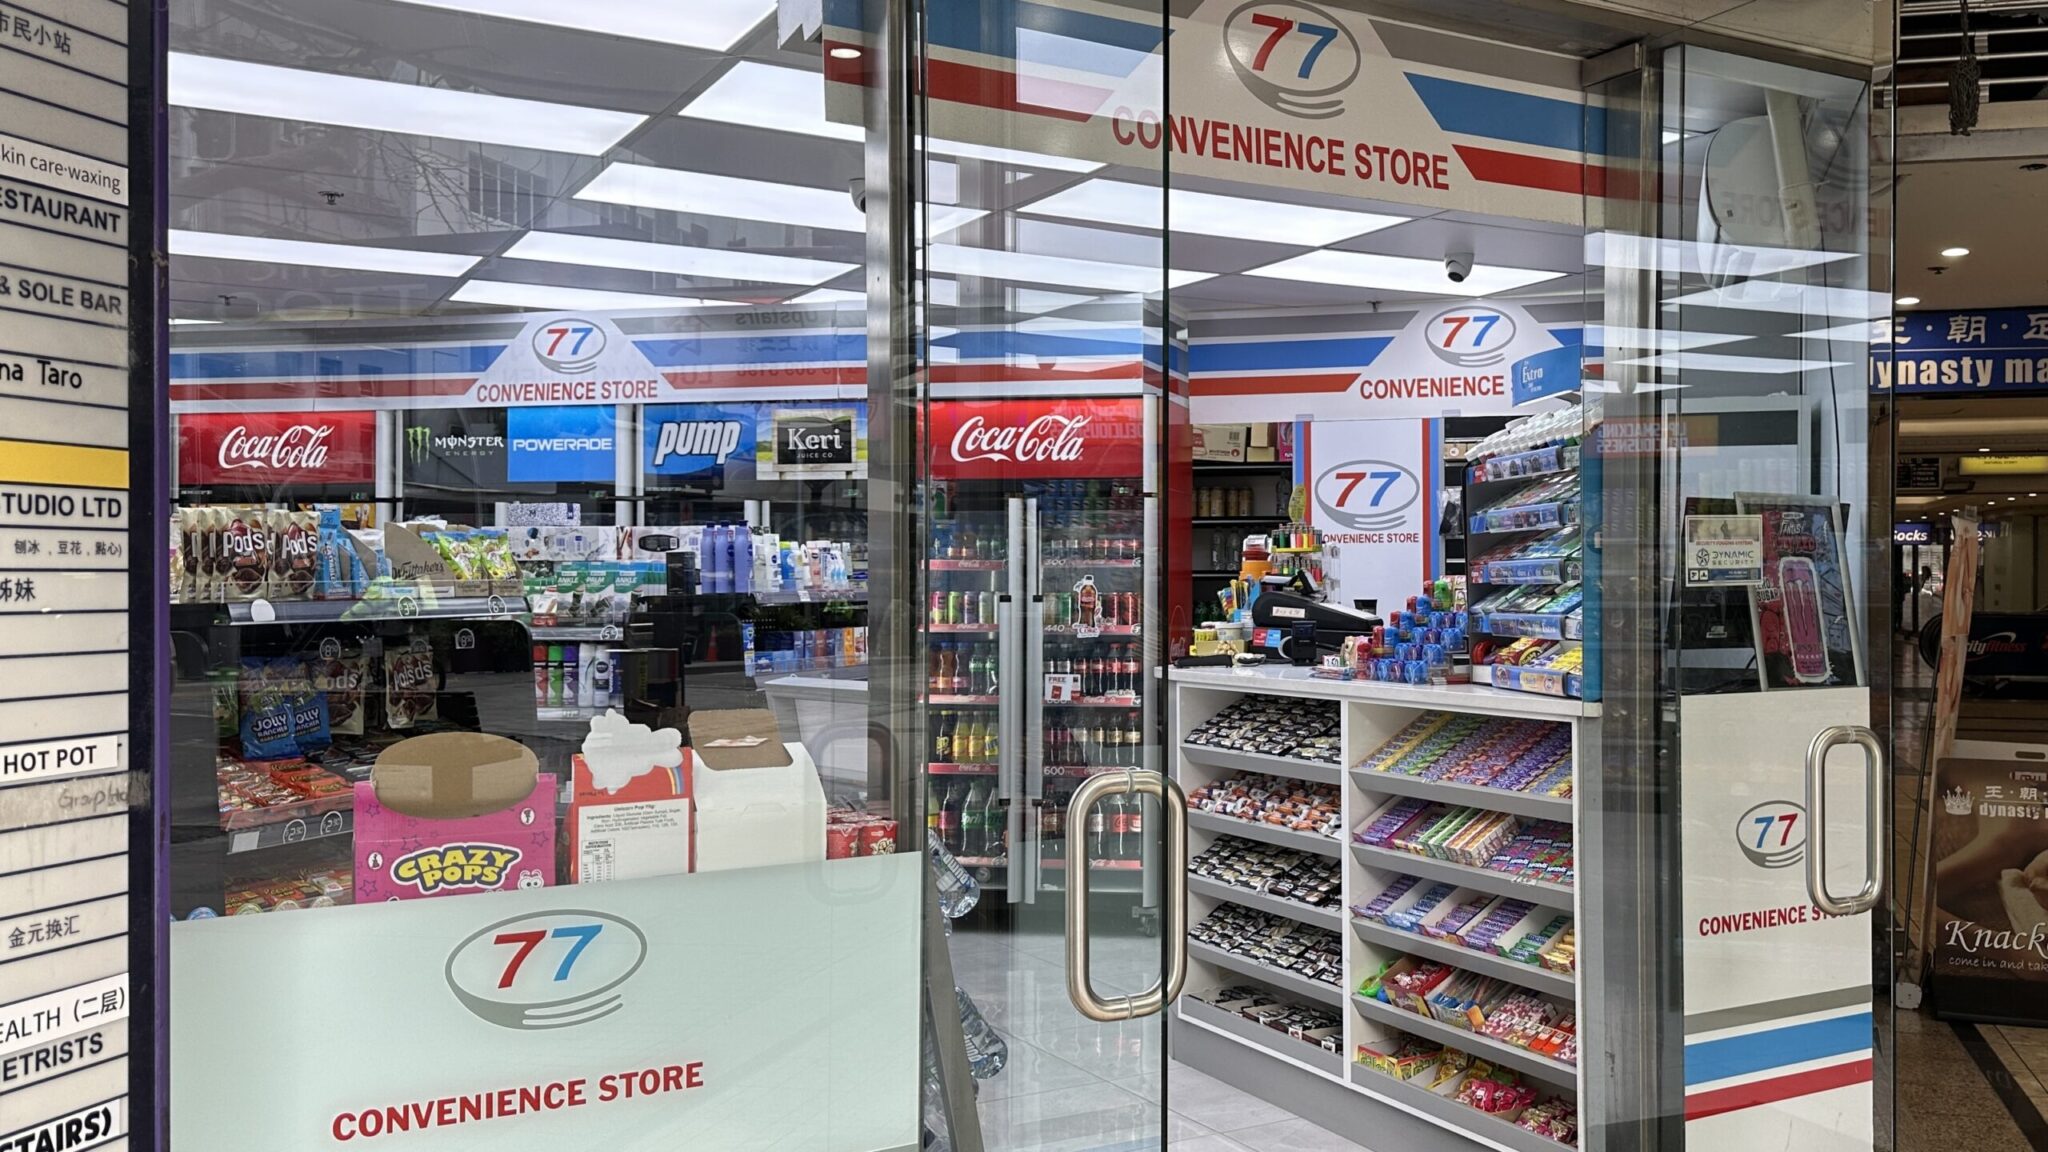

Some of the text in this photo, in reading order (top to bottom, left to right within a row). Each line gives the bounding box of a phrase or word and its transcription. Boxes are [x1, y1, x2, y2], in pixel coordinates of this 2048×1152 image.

[1251, 13, 1338, 80] 77
[1113, 106, 1449, 190] CONVENIENCE STORE
[19, 279, 74, 307] SOLE
[80, 290, 122, 315] BAR
[546, 327, 594, 356] 77
[1443, 315, 1500, 348] 77
[37, 360, 83, 390] Taro
[1522, 366, 1544, 383] Extra
[1870, 356, 1993, 388] ynasty
[477, 380, 658, 402] CONVENIENCE STORE
[1360, 375, 1504, 399] CONVENIENCE
[513, 437, 612, 451] POWERADE
[654, 421, 742, 466] pump
[788, 427, 842, 451] Keri
[1335, 471, 1401, 507] 77
[83, 496, 122, 518] LTD
[223, 530, 266, 557] Pods
[281, 533, 318, 559] Pods
[1322, 532, 1419, 544] ONVENIENCE STORE
[1712, 550, 1754, 559] DYNAMIC
[1044, 624, 1065, 632] 440
[326, 668, 359, 690] ods
[252, 714, 287, 732] JOLLY
[296, 708, 319, 724] OLLY
[296, 720, 320, 731] ANCHER
[4, 745, 97, 774] HOT POT
[1044, 766, 1065, 775] 600
[1980, 802, 2039, 819] dynasty
[1754, 813, 1798, 848] 77
[398, 850, 514, 879] CRAZY
[421, 866, 499, 888] POPS
[8, 914, 80, 949] 金元换汇
[1699, 905, 1807, 936] CONVENIENCE
[1945, 920, 2048, 960] Knack
[493, 924, 603, 989] 77
[1949, 956, 1979, 967] come
[1982, 956, 1996, 967] in
[2000, 956, 2024, 969] and
[3, 1032, 104, 1082] ETRISTS
[332, 1061, 703, 1141] CONVENIENCE STORE
